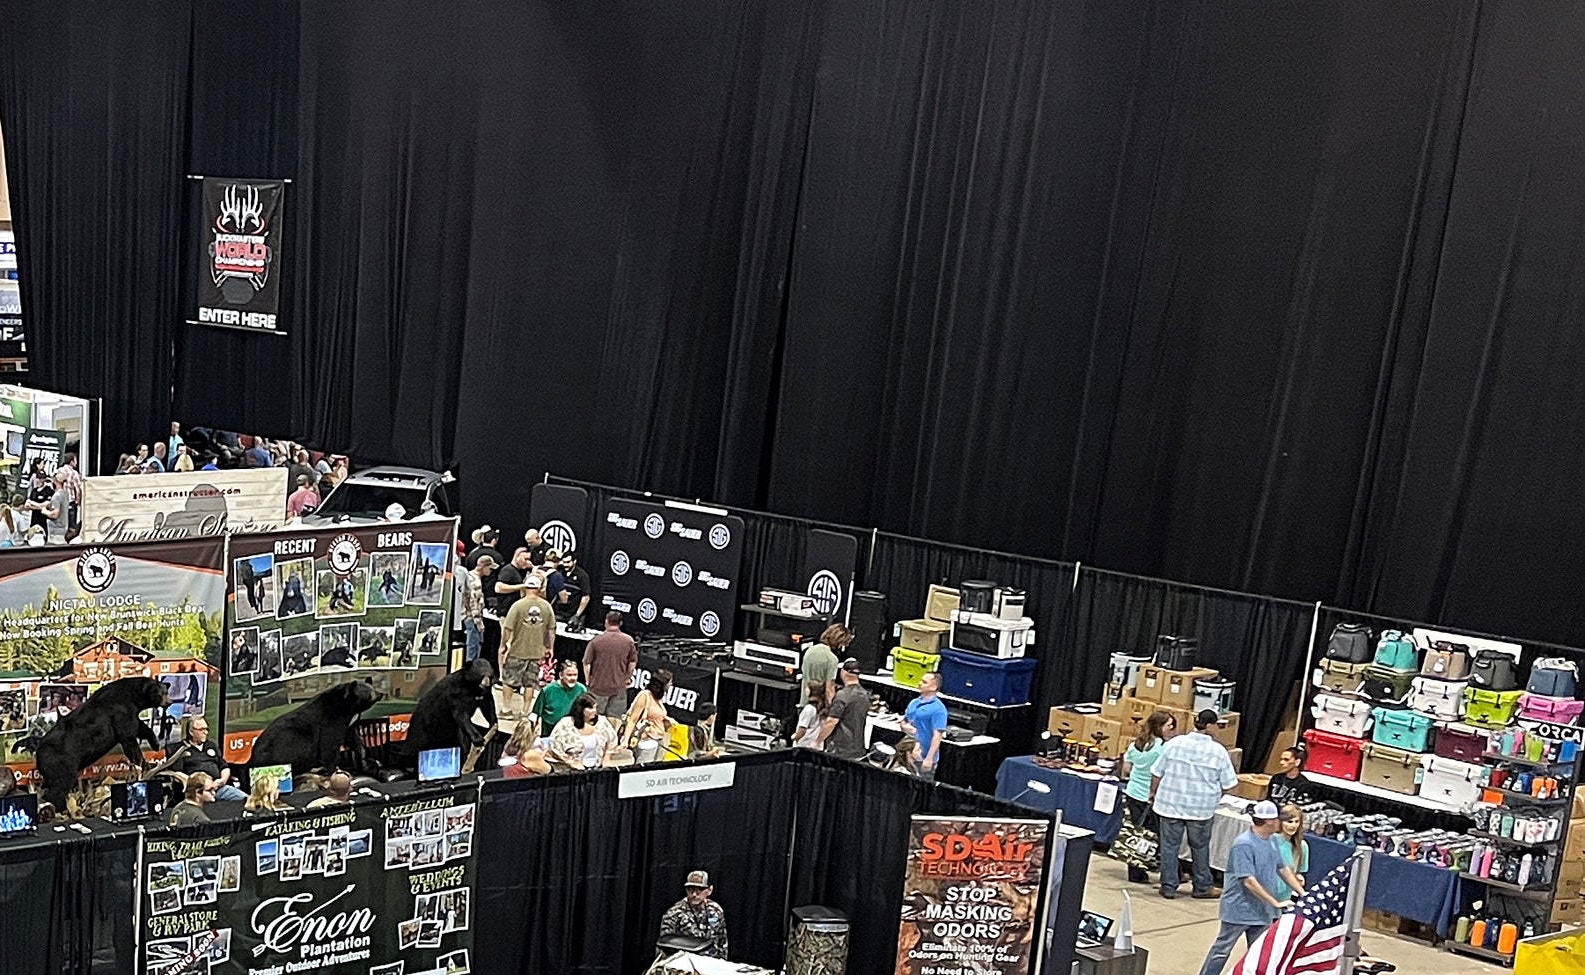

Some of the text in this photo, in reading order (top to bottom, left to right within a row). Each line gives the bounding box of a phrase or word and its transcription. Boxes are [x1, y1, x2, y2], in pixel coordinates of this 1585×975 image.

[215, 241, 266, 260] WORLD
[199, 307, 276, 329] ENTER HERE
[274, 532, 413, 556] RECENT BEARS
[50, 595, 140, 611] NICTAU LODGE
[3, 614, 69, 629] Headquarters
[71, 613, 84, 622] for
[87, 612, 108, 622] New
[110, 608, 156, 620] Brunswick
[159, 606, 183, 616] Black
[0, 631, 21, 641] Now
[23, 628, 62, 640] Booking
[64, 625, 95, 637] Spring
[117, 621, 134, 632] Fall
[1539, 724, 1581, 742] ORCA
[322, 812, 357, 828] FISHING
[408, 866, 465, 886] WEDDINGS
[423, 876, 462, 892] EVENTS
[946, 887, 996, 902] STOP
[926, 904, 1013, 921] MASKING
[933, 922, 1001, 938] ODORS
[193, 931, 216, 957] SOON
[301, 935, 370, 958] Plantation
[969, 944, 995, 953] 100%
[997, 945, 1009, 954] of
[286, 960, 319, 975] Outdoor
[322, 950, 371, 968] Adventures
[908, 950, 938, 959] Odors
[955, 952, 994, 963] Hunting
[995, 953, 1020, 963] Gear
[921, 966, 935, 975] No
[937, 967, 962, 975] Need
